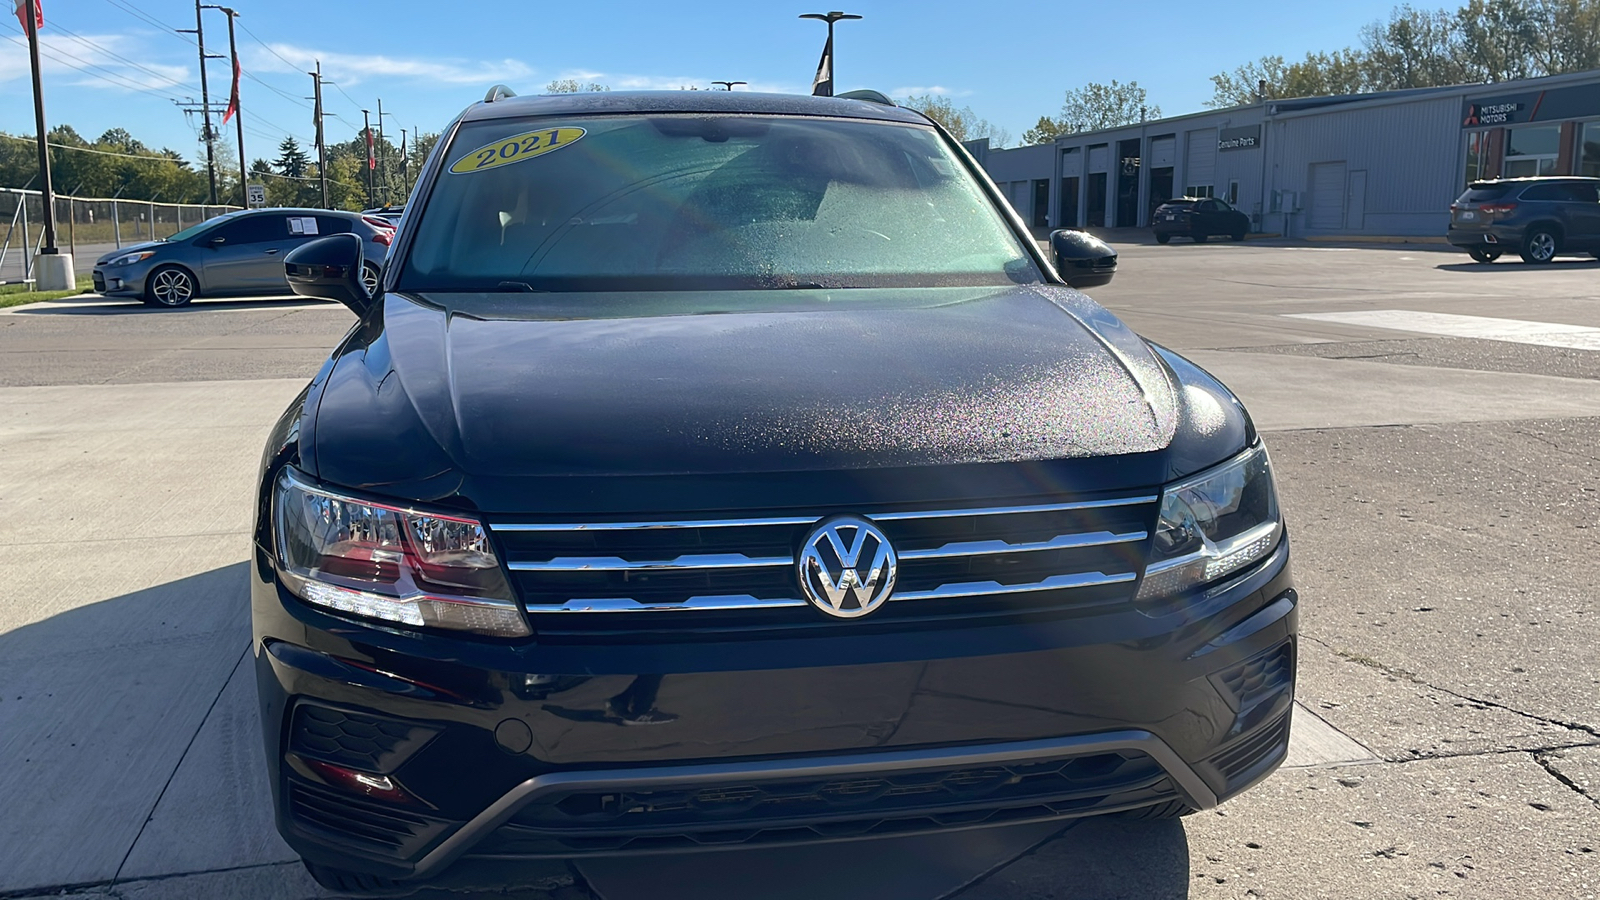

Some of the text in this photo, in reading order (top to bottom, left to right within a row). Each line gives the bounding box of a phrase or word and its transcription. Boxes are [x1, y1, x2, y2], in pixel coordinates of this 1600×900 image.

[1480, 103, 1517, 115] MITSUBISHI
[1480, 113, 1507, 124] MOTORS
[476, 130, 561, 168] 2021
[1218, 137, 1255, 149] Genuine Parts
[250, 194, 264, 202] 35
